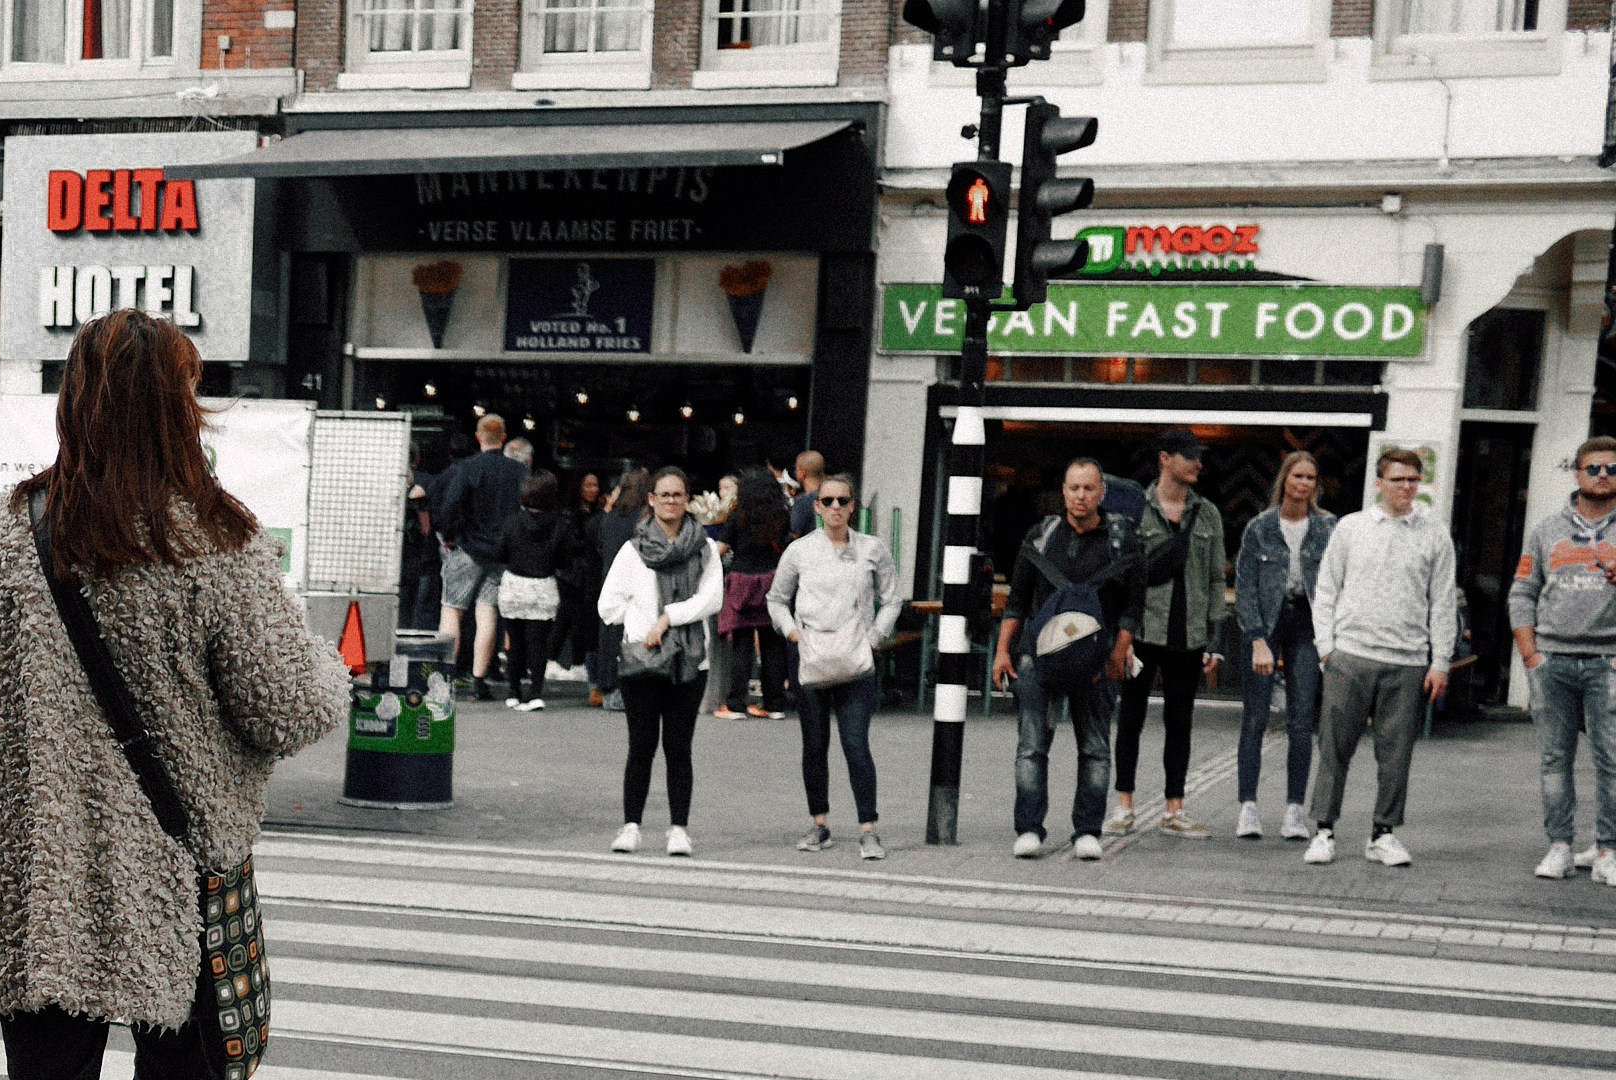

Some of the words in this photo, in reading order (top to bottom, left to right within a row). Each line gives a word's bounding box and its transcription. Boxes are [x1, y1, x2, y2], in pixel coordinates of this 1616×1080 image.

[48, 168, 199, 231] DELTA
[428, 220, 497, 241] VERSE
[510, 220, 616, 241] VLAAMSE
[630, 219, 694, 241] FRIET
[1125, 226, 1260, 254] maoz
[40, 265, 200, 327] HOTEL
[530, 320, 581, 333] VOTED
[614, 316, 626, 334] 1
[899, 300, 1078, 336] VEAN
[1107, 302, 1229, 338] FAST
[1255, 302, 1414, 340] FOOD
[516, 335, 590, 349] HOLLAND
[595, 336, 641, 349] FRIES
[301, 373, 322, 390] 41
[13, 463, 35, 473] we
